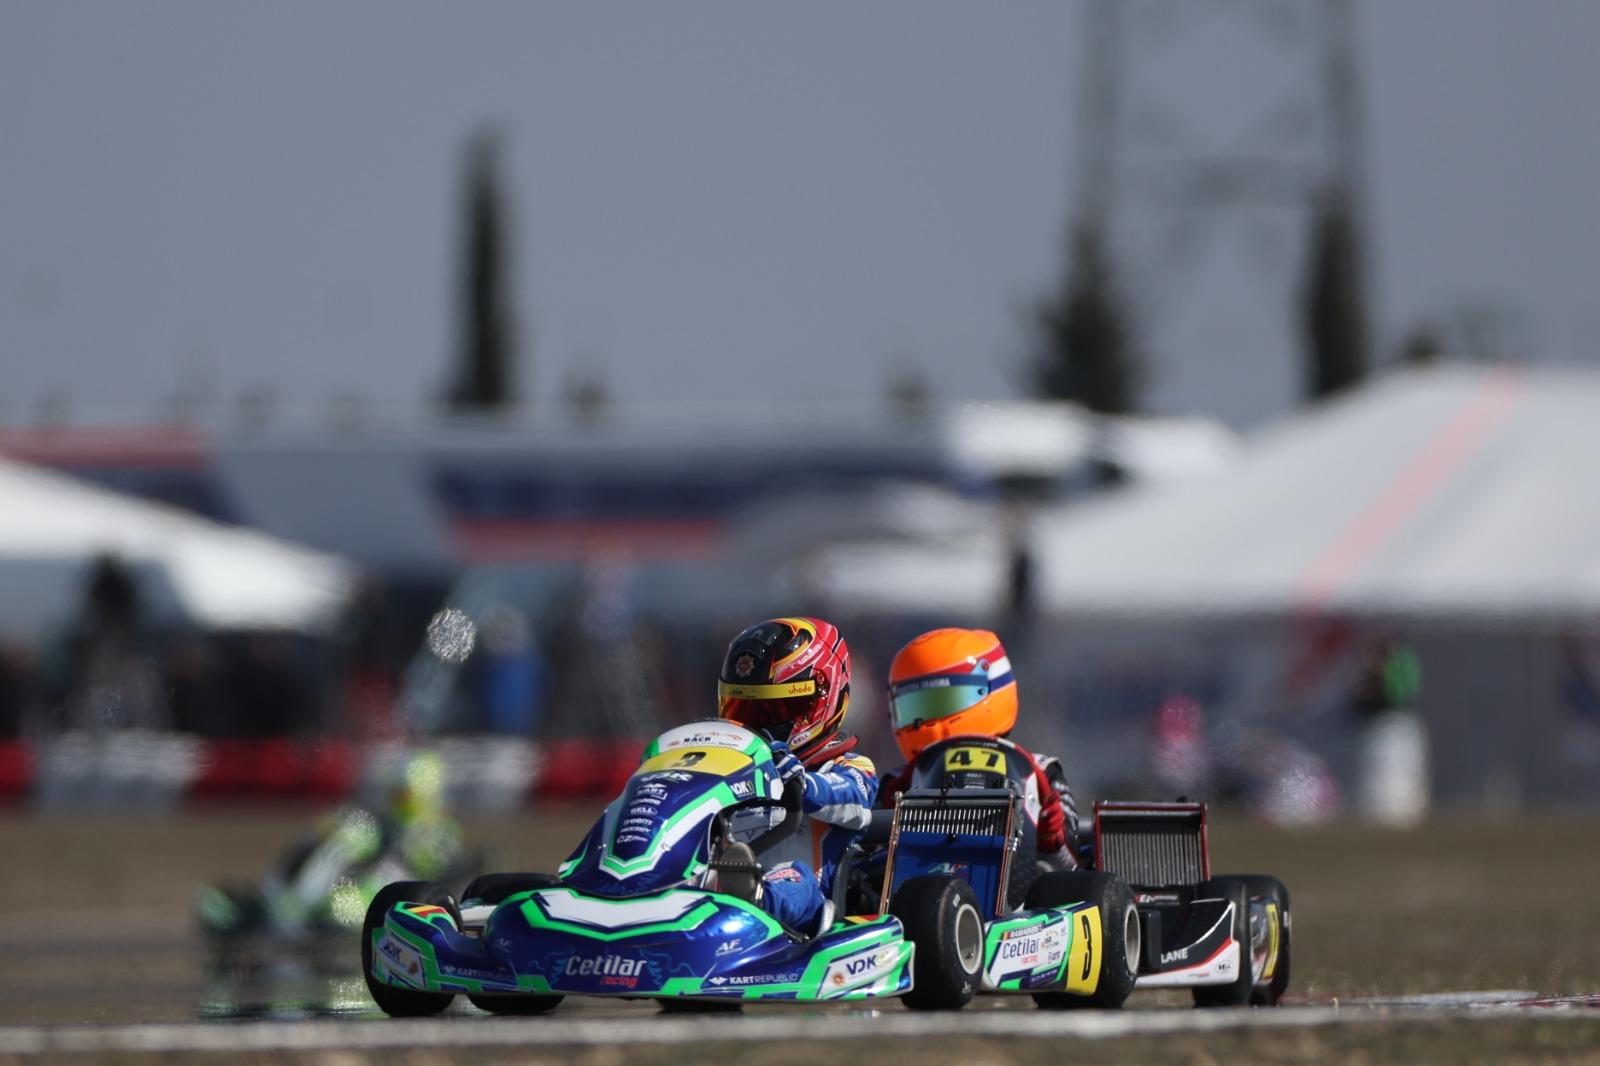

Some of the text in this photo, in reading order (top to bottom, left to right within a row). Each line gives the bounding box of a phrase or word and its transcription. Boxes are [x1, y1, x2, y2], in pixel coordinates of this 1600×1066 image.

[672, 751, 707, 768] 3
[948, 749, 999, 768] 47
[1002, 938, 1041, 960] Cetilar
[1160, 947, 1188, 964] LANE
[565, 954, 648, 977] Cetilar
[846, 954, 876, 975] VDK
[599, 975, 639, 989] racing
[729, 973, 799, 985] KARTREPUBLIC
